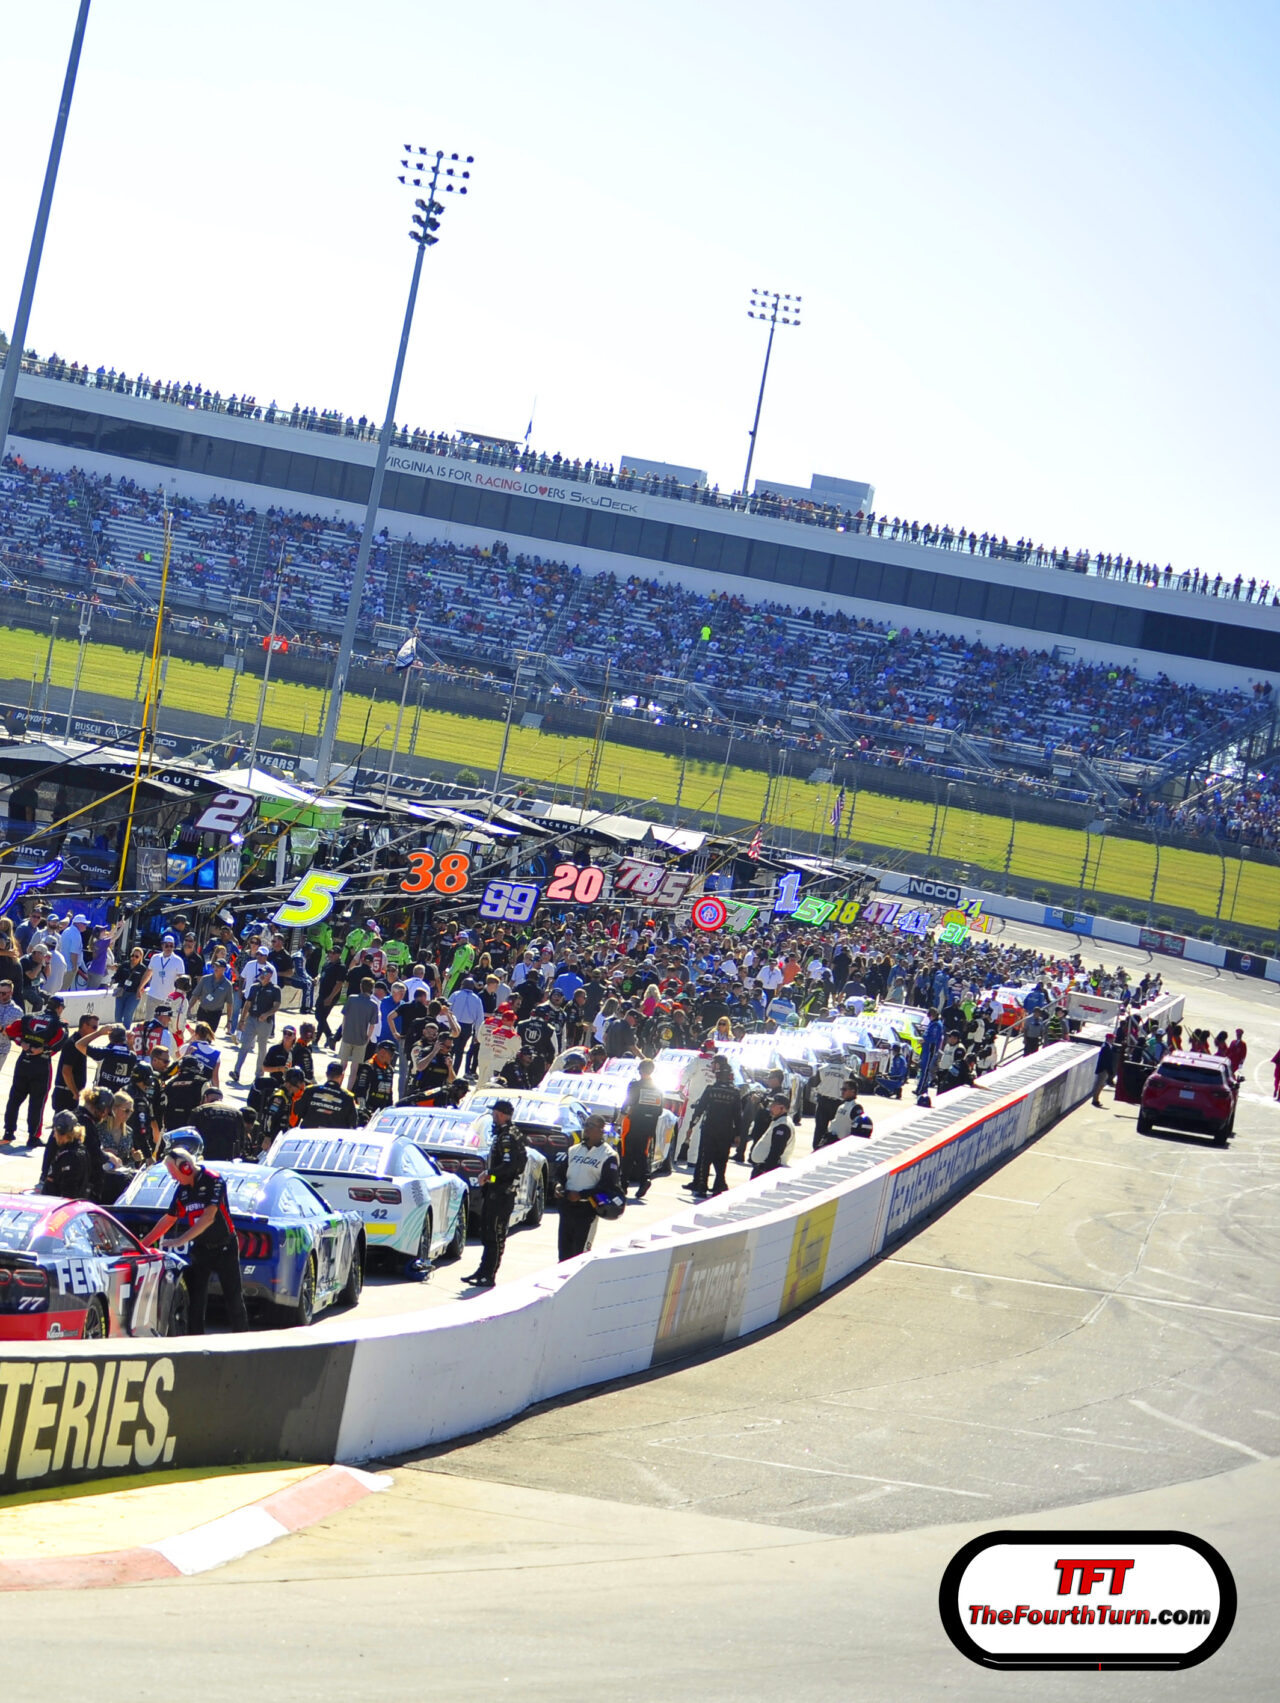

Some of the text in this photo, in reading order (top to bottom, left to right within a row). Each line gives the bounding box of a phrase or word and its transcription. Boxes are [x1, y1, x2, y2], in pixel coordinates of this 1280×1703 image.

[385, 455, 434, 476] VIRGINIA
[437, 466, 447, 477] IS
[448, 469, 472, 483] FOR
[474, 474, 523, 492] RACING
[74, 721, 102, 735] BUSCH
[151, 737, 177, 749] EICO
[260, 753, 295, 771] YEARS
[196, 793, 253, 833] 2
[80, 863, 113, 876] Quincy
[400, 850, 472, 895] 38
[616, 857, 667, 895] 78
[546, 862, 605, 904] 20
[775, 872, 801, 913] 1
[910, 880, 959, 901] NOCO
[271, 868, 351, 928] 5
[479, 881, 540, 922] 99
[957, 898, 985, 918] 24
[791, 896, 838, 927] 51
[940, 921, 969, 945] 31
[970, 913, 994, 935] 21
[310, 1101, 343, 1112] CHEVROLET
[371, 1208, 388, 1220] 42
[243, 1265, 256, 1275] 51
[17, 1296, 45, 1311] 77
